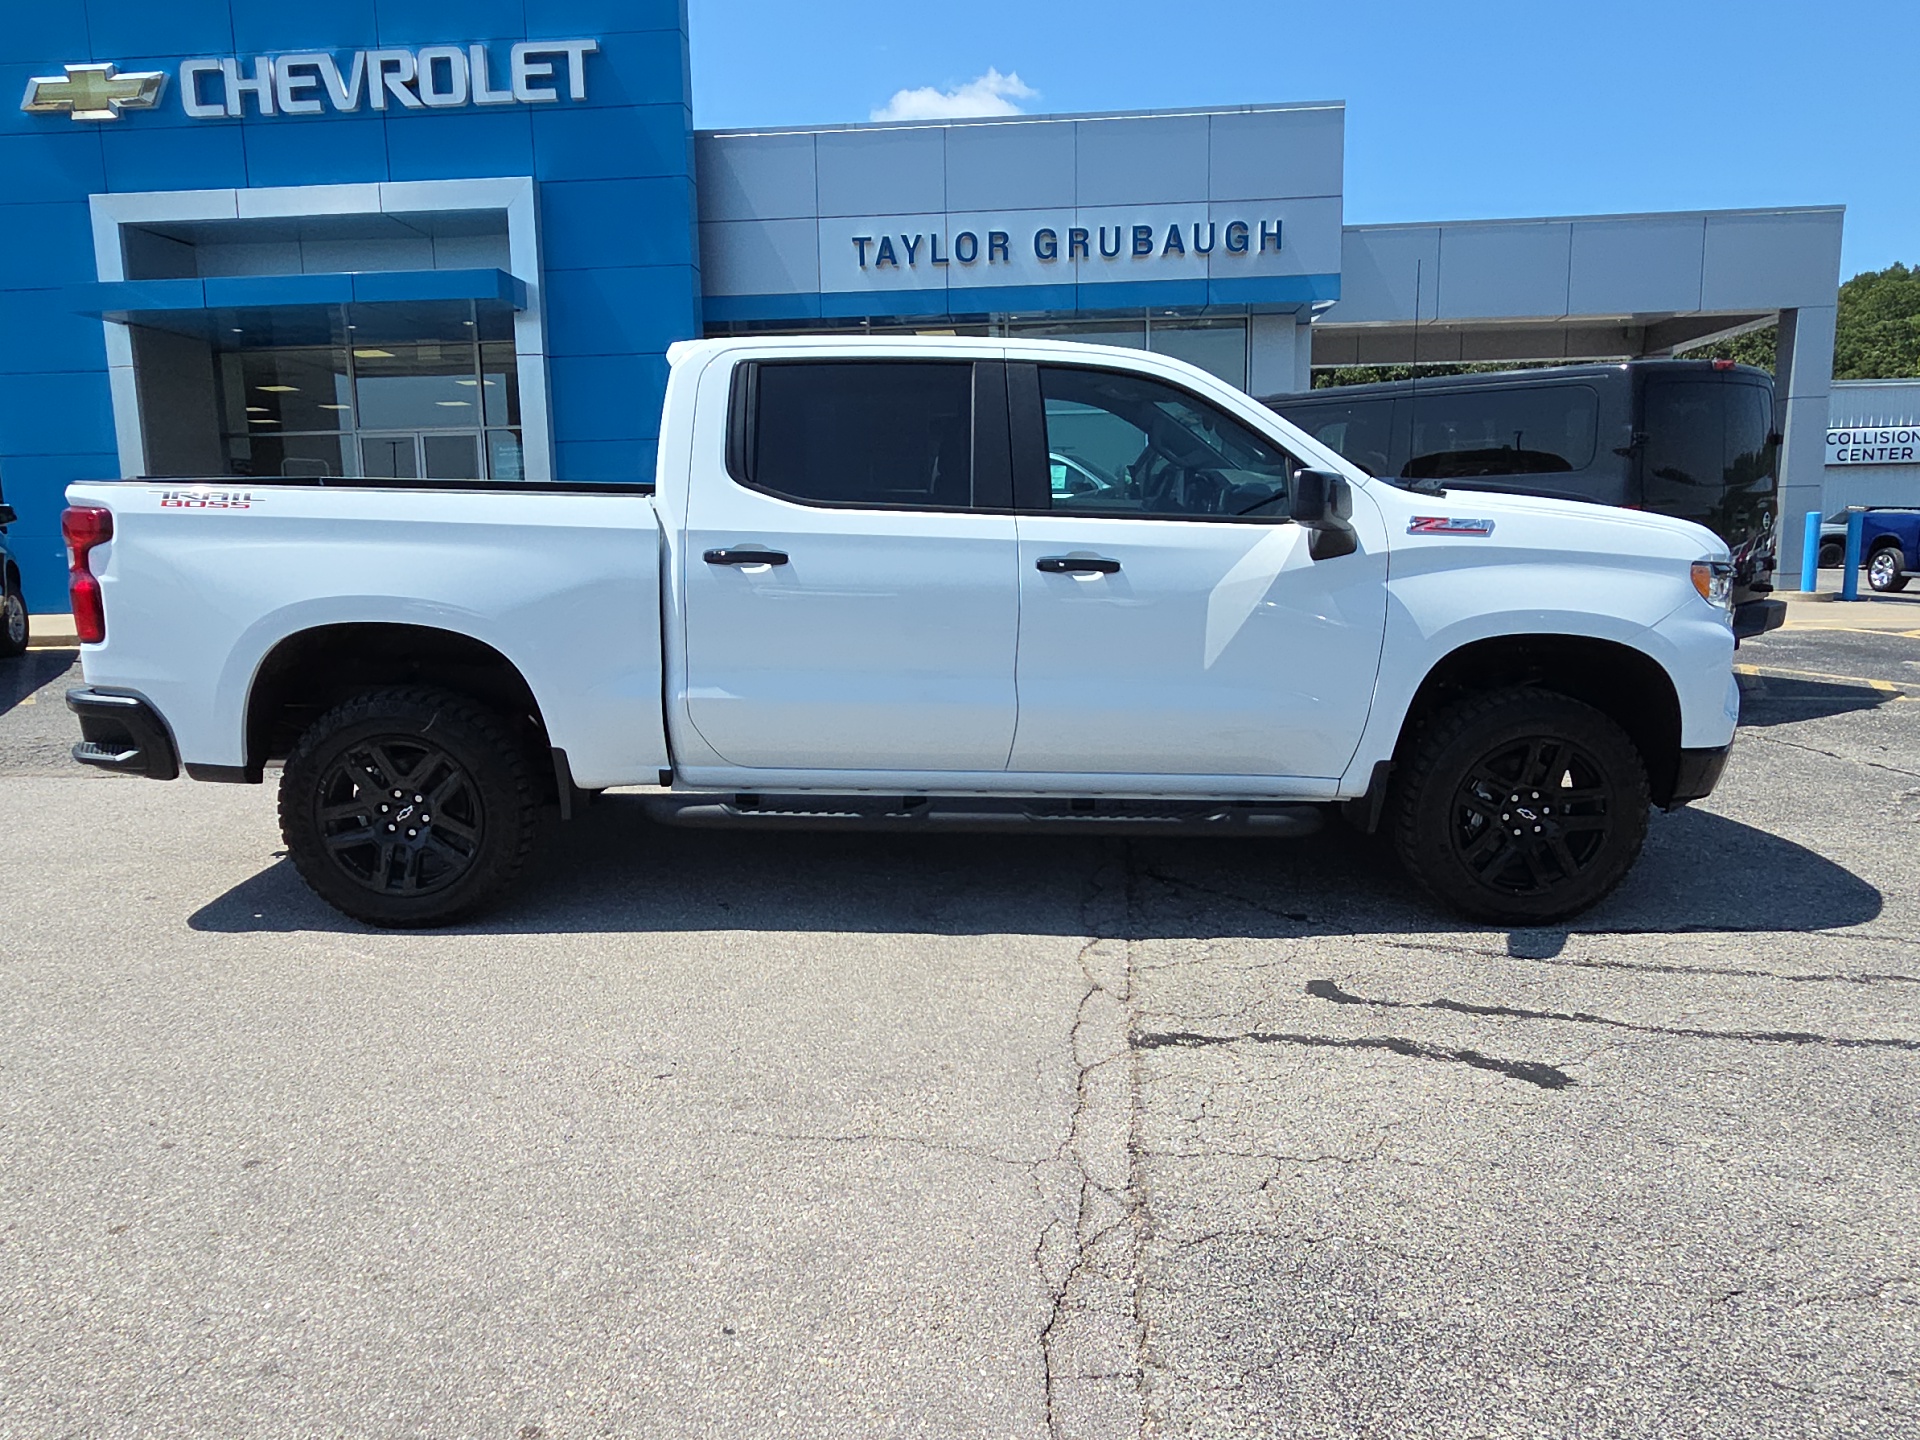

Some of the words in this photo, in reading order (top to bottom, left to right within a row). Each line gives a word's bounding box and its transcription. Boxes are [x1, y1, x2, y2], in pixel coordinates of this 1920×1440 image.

[180, 40, 598, 117] CHEVROLET
[852, 230, 1010, 268] TAYLOR
[1034, 219, 1283, 261] GRUBAUGH
[1826, 430, 1920, 445] COLLISION
[1836, 447, 1914, 462] CENTER
[161, 500, 250, 509] BOSS
